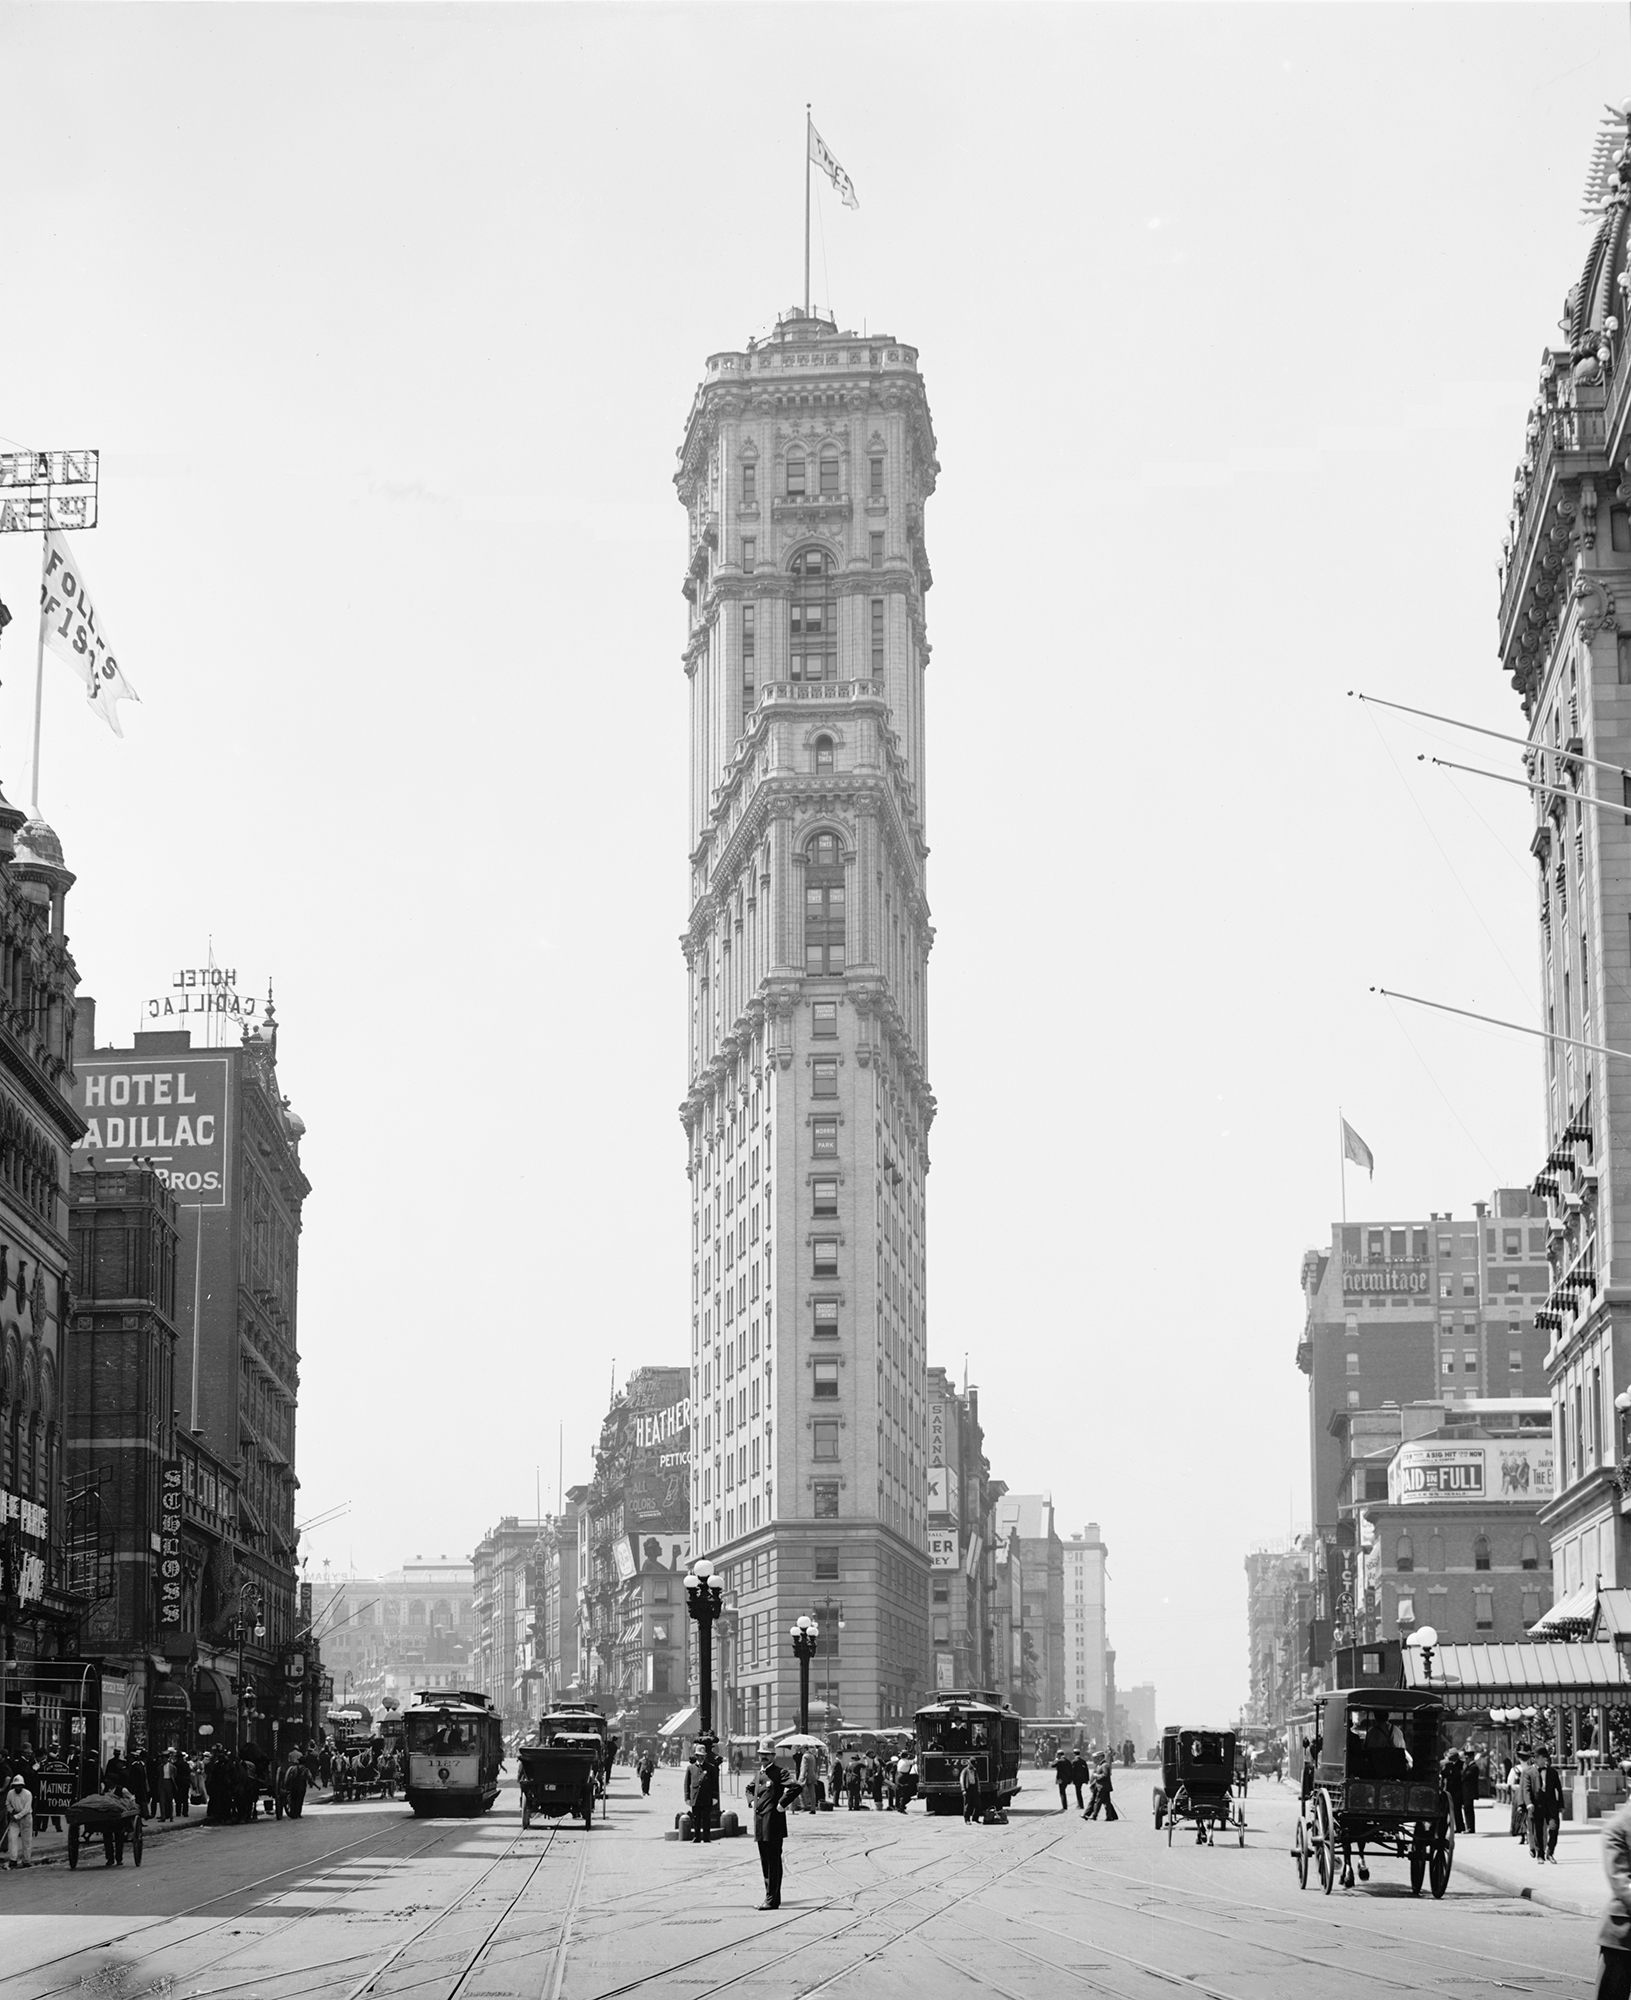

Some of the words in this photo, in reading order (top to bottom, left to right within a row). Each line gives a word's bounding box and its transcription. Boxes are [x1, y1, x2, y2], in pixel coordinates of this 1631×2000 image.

[84, 1072, 197, 1107] HOTEL
[71, 1115, 215, 1149] ADILLAC
[632, 1480, 648, 1494] ALL
[1403, 1468, 1425, 1491] AID
[1426, 1474, 1437, 1483] IN
[1439, 1467, 1481, 1489] FULL
[1532, 1468, 1545, 1485] THE
[629, 1498, 657, 1511] COLORS
[535, 1552, 545, 1656] BROADWAY
[427, 1759, 460, 1767] 1127
[40, 1780, 73, 1801] MATINEE
